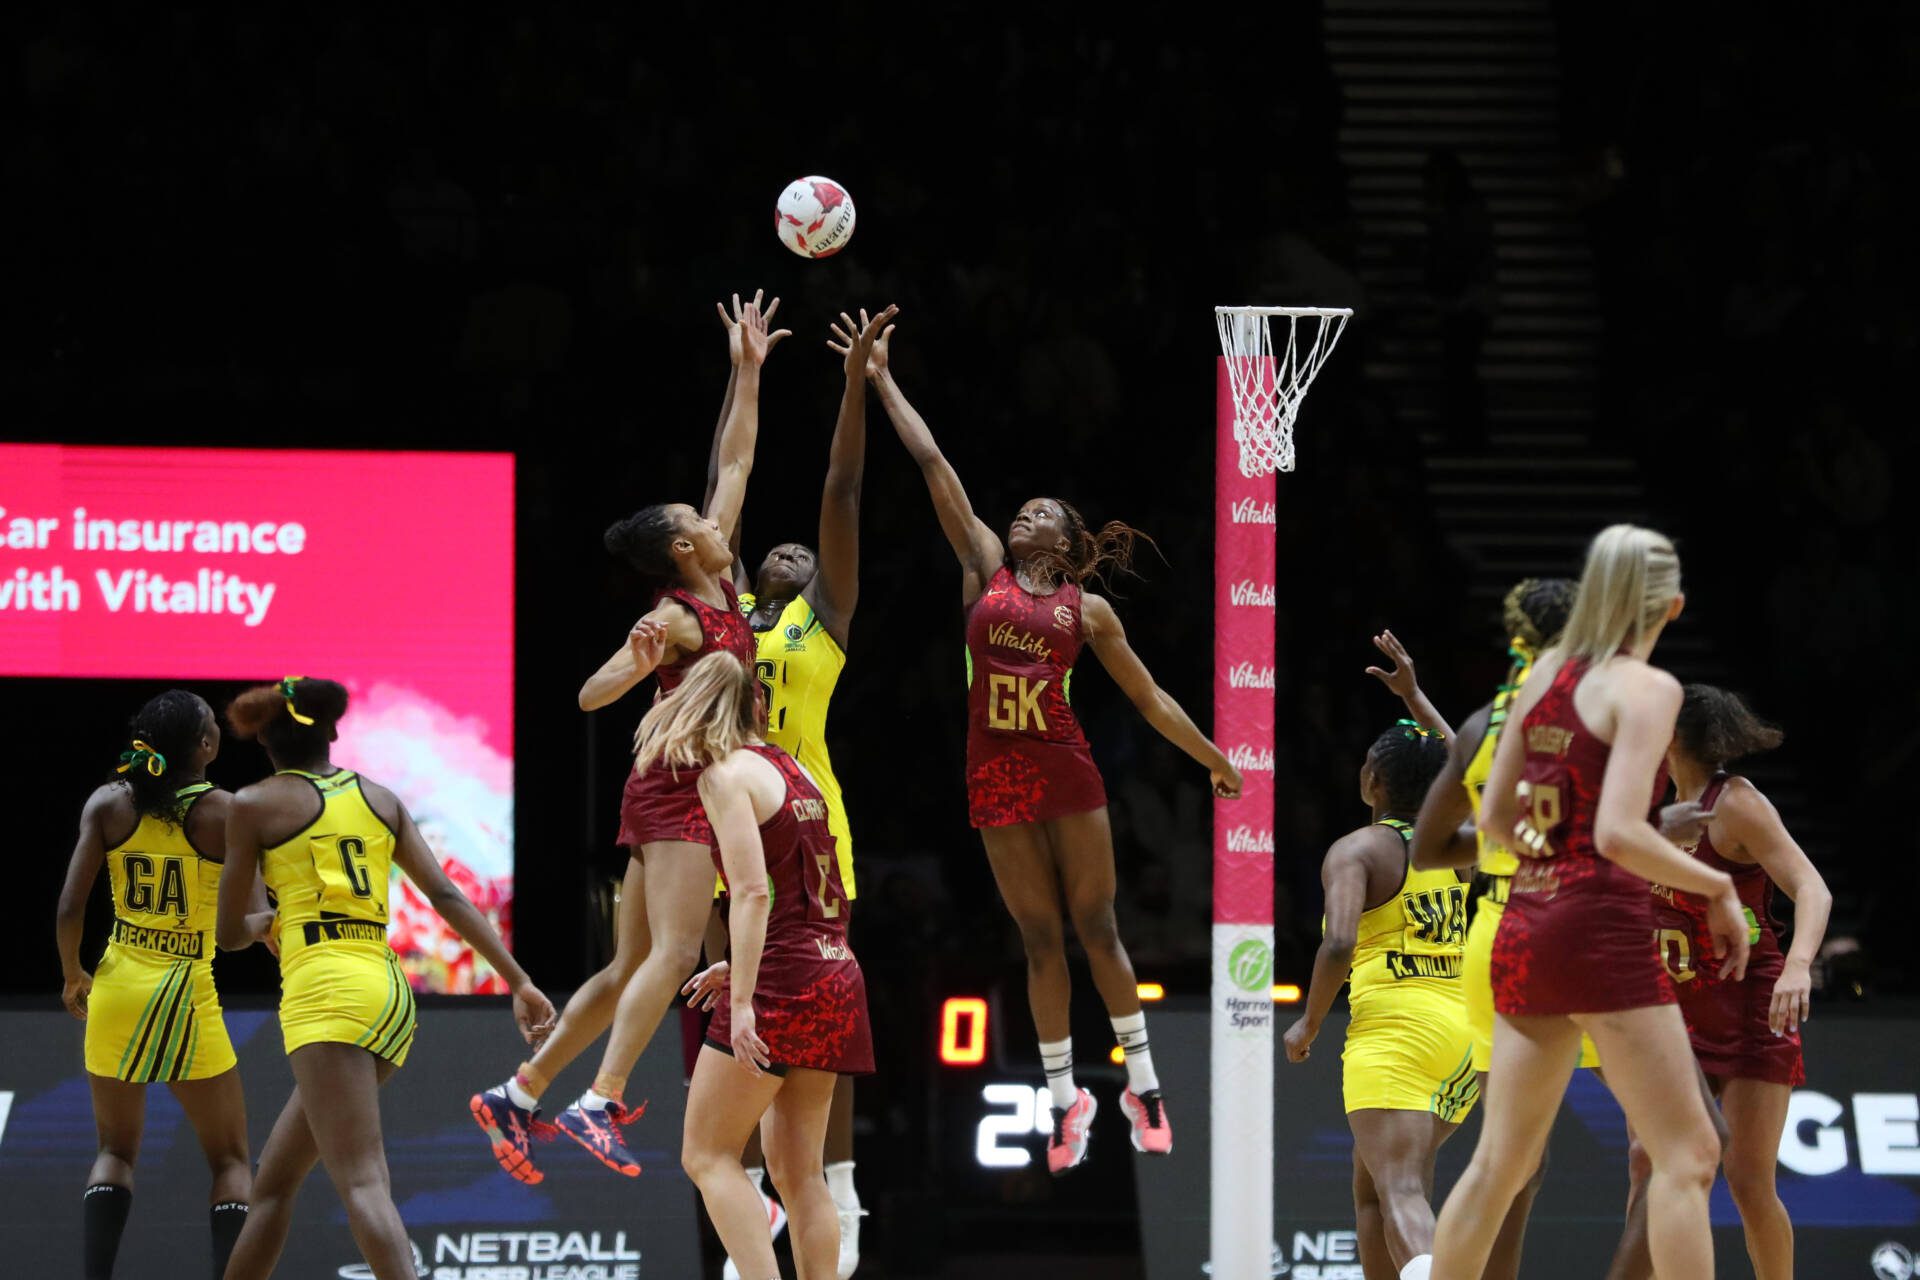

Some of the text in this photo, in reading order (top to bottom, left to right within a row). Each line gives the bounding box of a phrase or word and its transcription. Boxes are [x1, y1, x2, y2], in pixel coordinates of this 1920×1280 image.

[73, 507, 306, 554] insurance
[1232, 497, 1276, 532] Vitali
[96, 568, 276, 627] Vitality
[1231, 579, 1275, 614] Vitali
[988, 621, 1052, 663] Vitality
[1230, 661, 1275, 696] Vitali
[988, 673, 1049, 732] GK
[1229, 743, 1275, 778] Vitali
[1227, 824, 1274, 860] Vitali
[123, 854, 189, 917] GA
[336, 836, 372, 900] C
[1404, 886, 1465, 945] WA
[120, 924, 200, 956] BECKFORD
[1392, 956, 1413, 977] K.
[939, 997, 989, 1066] 0
[434, 1231, 641, 1263] NETBALL
[532, 1265, 640, 1280] LEAGUE
